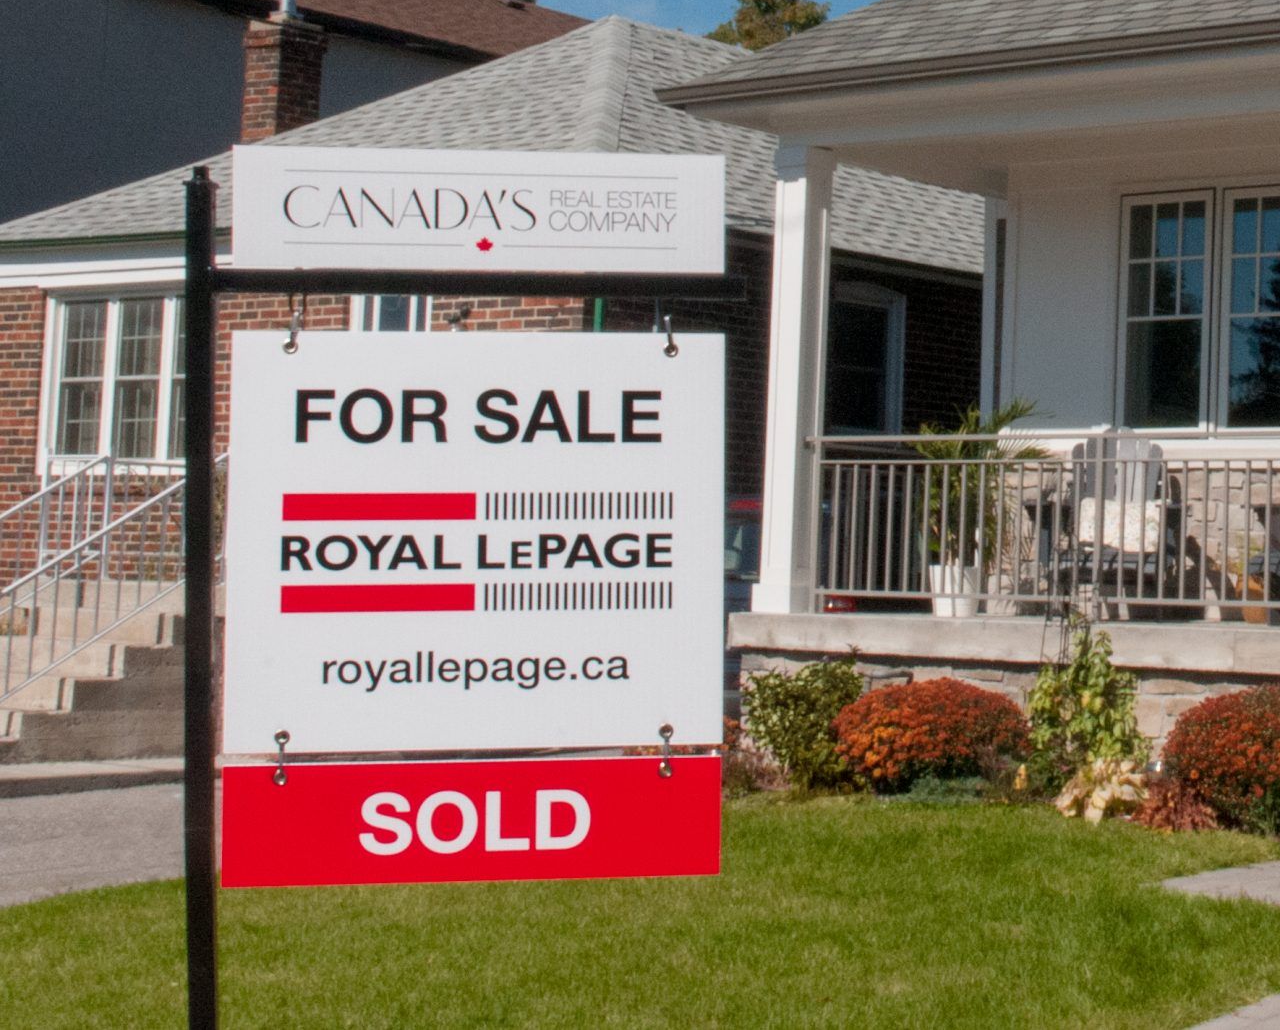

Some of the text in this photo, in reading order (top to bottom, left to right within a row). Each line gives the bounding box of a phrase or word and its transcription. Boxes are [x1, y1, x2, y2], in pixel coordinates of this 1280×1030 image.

[283, 184, 537, 232] CANADA'S
[549, 190, 678, 209] REAL ESTATE
[548, 210, 678, 232] COMPANY
[294, 388, 662, 444] FOR SALE
[280, 534, 462, 571] ROYAL
[321, 651, 630, 692] royallepage.ca
[358, 788, 591, 856] SOLD
